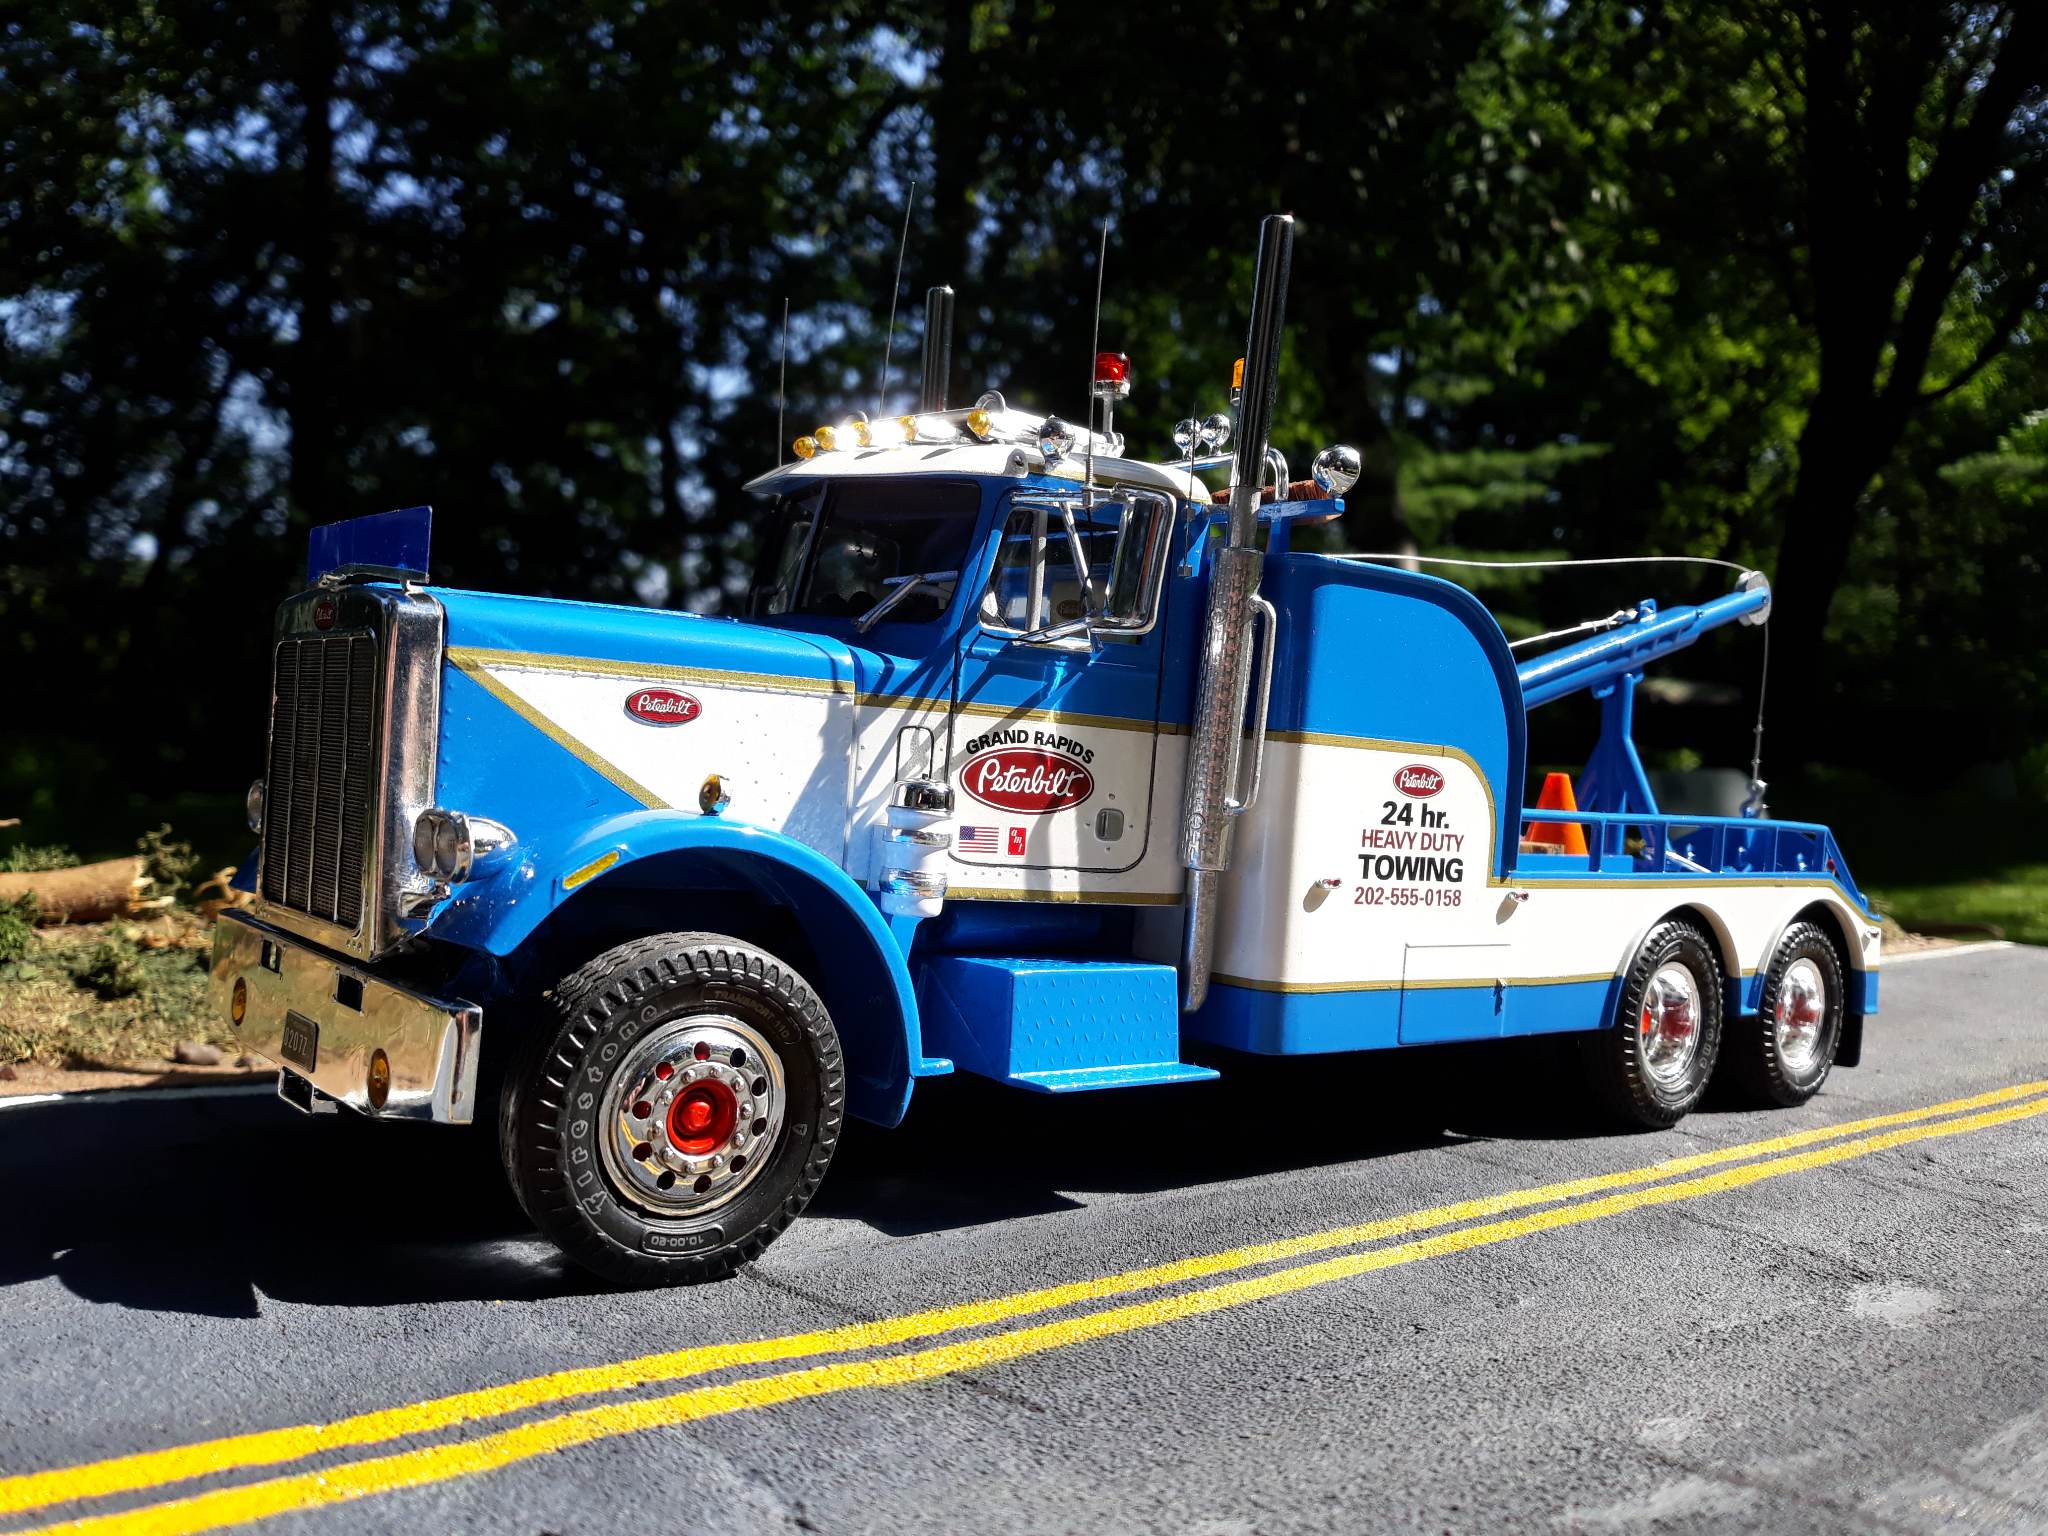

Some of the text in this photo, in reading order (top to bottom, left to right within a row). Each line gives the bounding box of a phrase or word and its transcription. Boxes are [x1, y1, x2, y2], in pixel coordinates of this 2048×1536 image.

[637, 694, 696, 715] Peterbilt
[966, 729, 1095, 765] GRAND RAPIDS
[978, 758, 1085, 797] Peterbilt
[1400, 770, 1442, 790] Peterbilt
[1381, 801, 1450, 829] 24 hr.
[1361, 829, 1465, 852] HEAVY DUTY
[1358, 854, 1464, 883] TOWING
[1354, 886, 1462, 907] 202-555-0158
